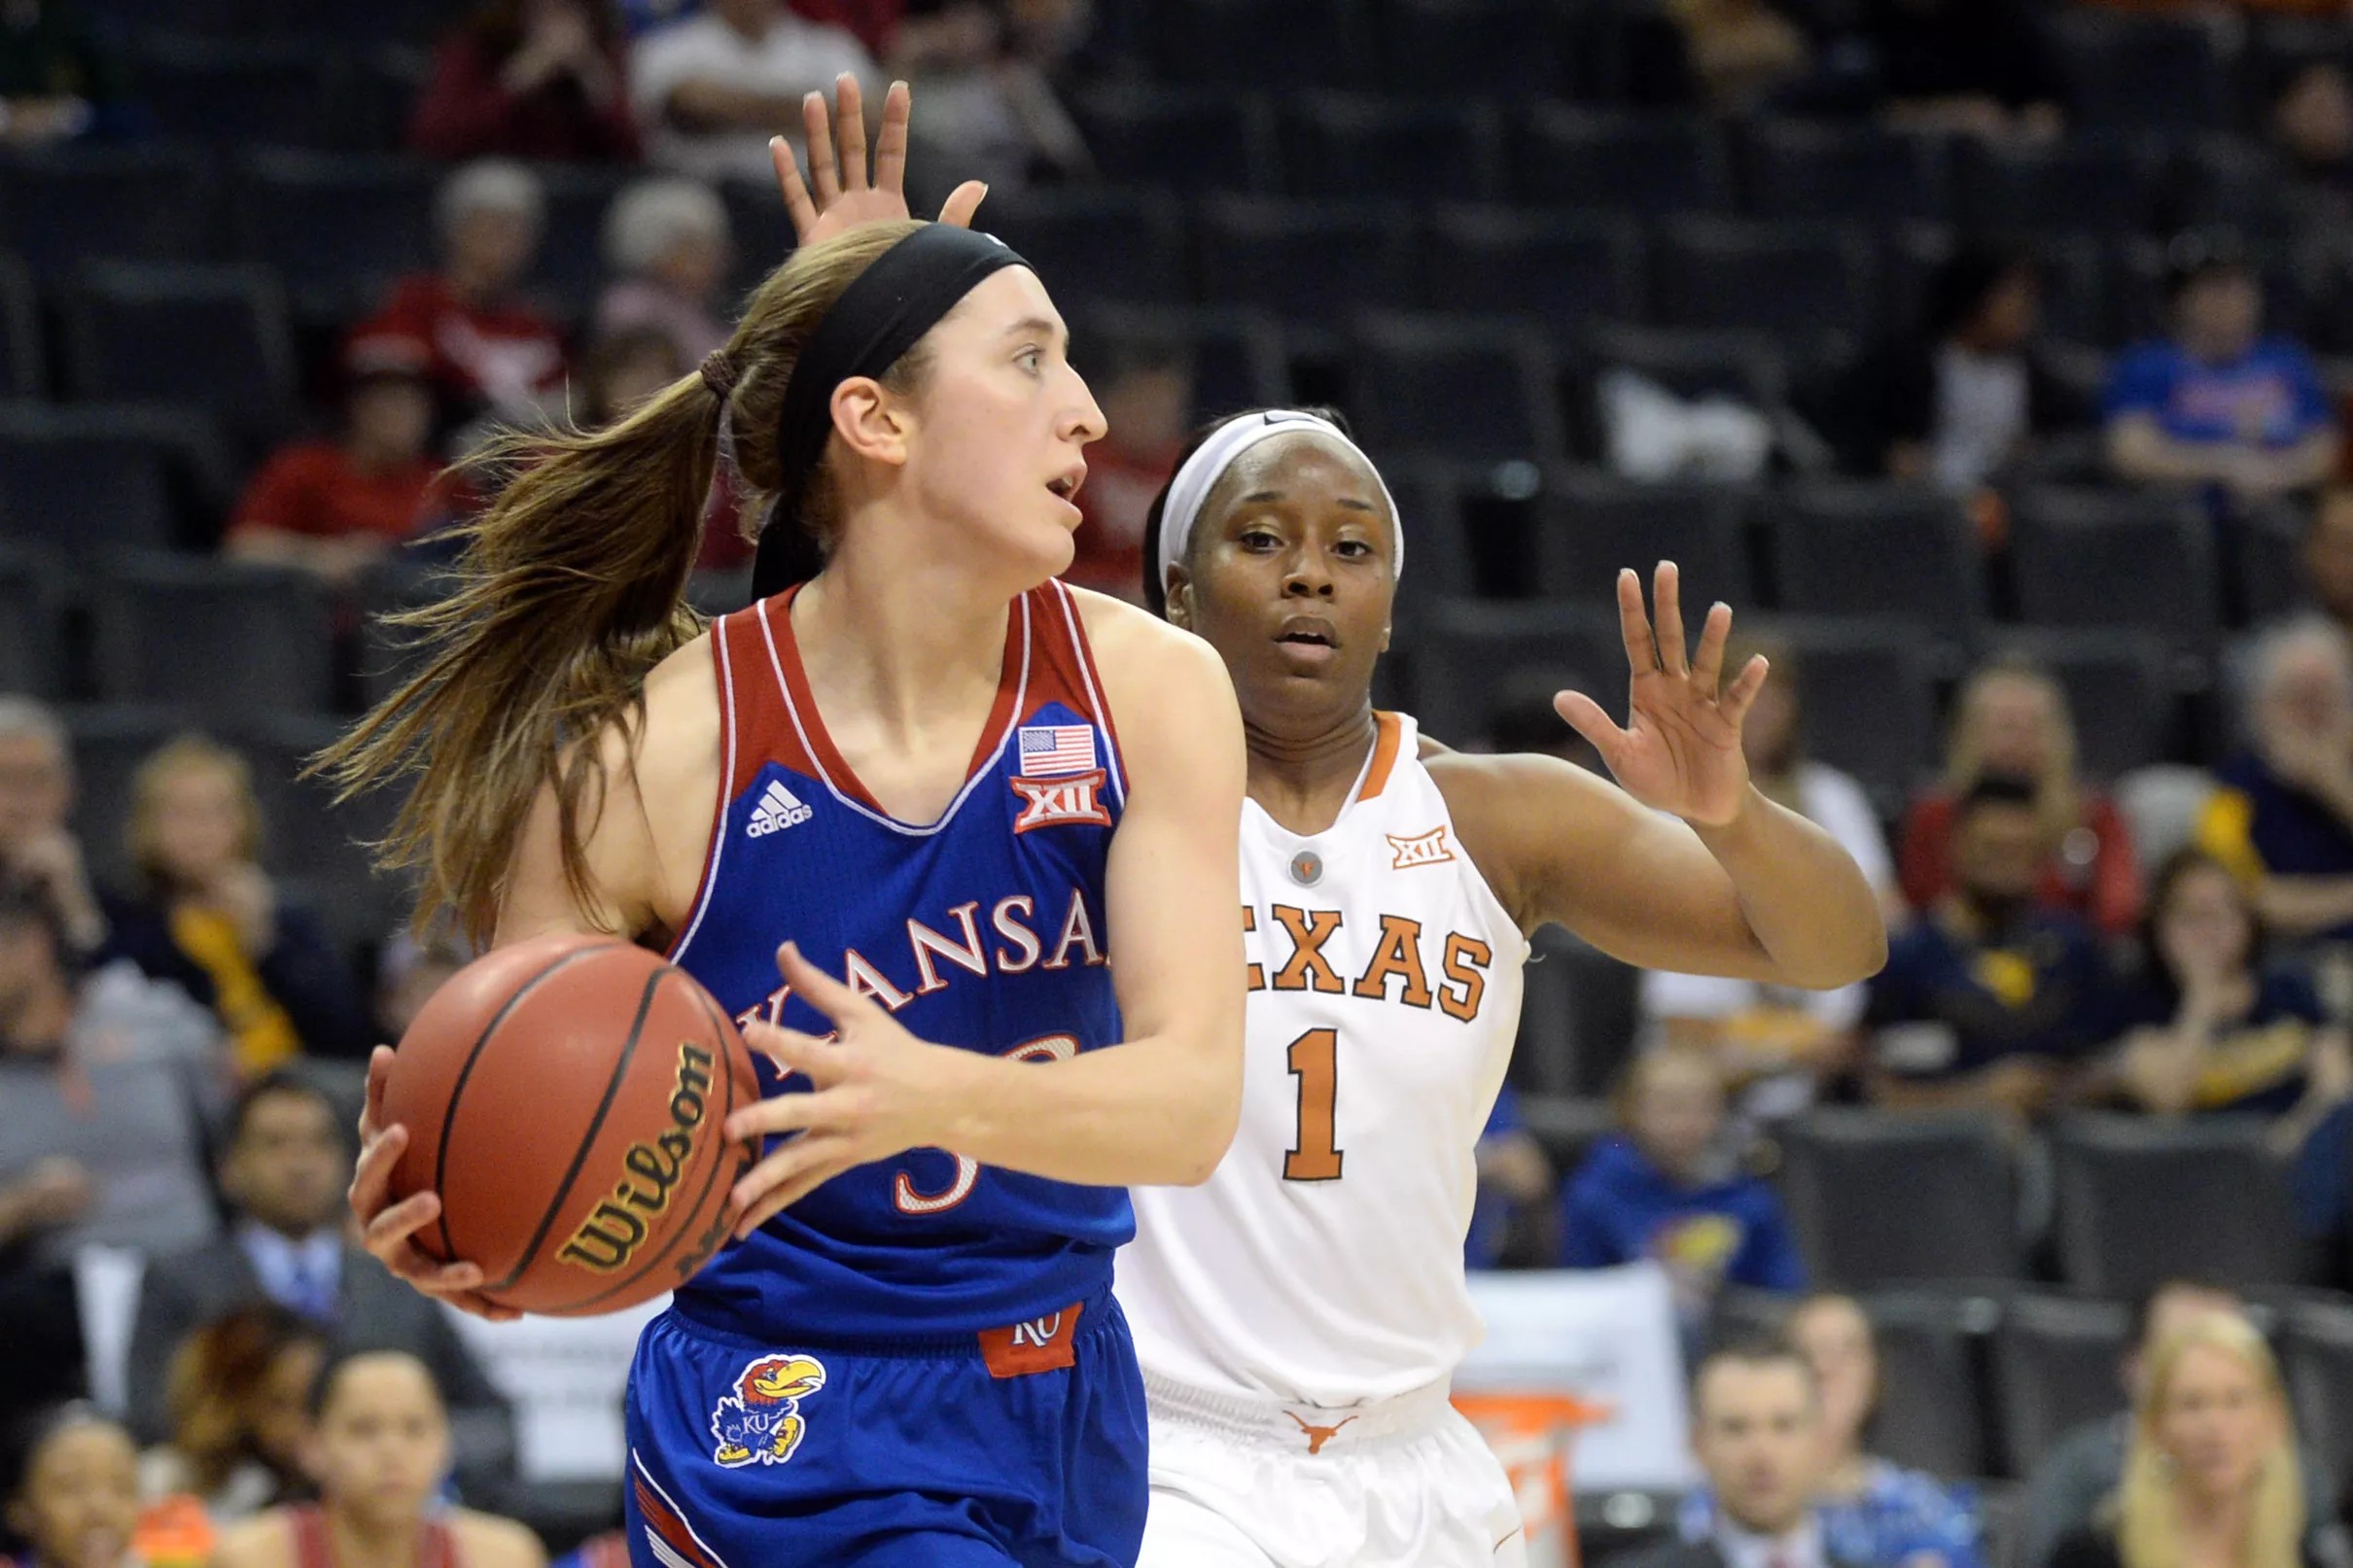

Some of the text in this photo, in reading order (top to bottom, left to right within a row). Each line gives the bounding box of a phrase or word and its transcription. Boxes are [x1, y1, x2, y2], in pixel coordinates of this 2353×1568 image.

[746, 803, 813, 838] adidas
[1014, 775, 1105, 827] XII
[1387, 827, 1455, 868] XII
[736, 887, 1111, 1081] KANSA
[1282, 1028, 1344, 1180] 1
[556, 1042, 715, 1273] Wilson
[743, 1413, 769, 1434] KU
